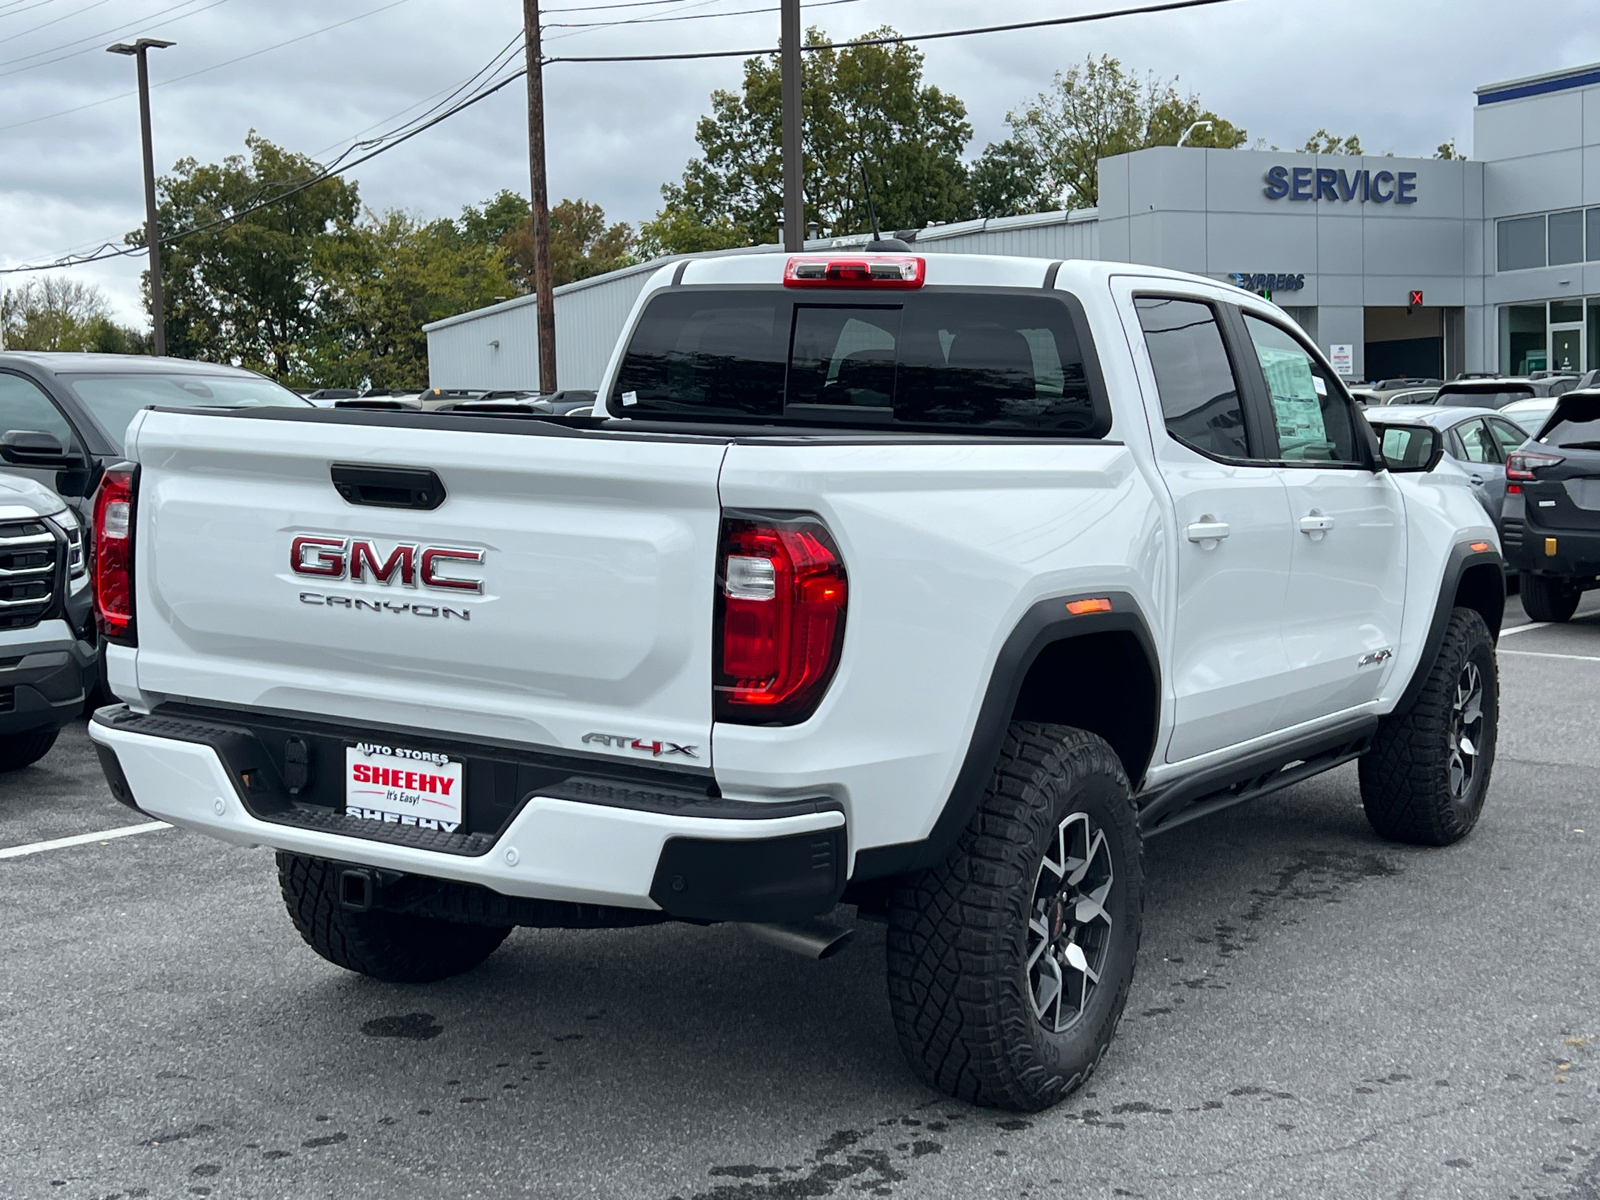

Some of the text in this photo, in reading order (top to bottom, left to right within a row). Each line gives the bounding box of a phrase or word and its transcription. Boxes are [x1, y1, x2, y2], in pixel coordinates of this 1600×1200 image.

[1265, 165, 1418, 204] SERVICE
[1233, 273, 1305, 291] EXPRESS
[290, 533, 485, 596] GMC
[299, 592, 471, 621] CANYON
[355, 742, 449, 764] AUTO STORES
[581, 732, 700, 759] AT4X
[352, 763, 455, 796] SHEEHY
[386, 790, 420, 806] It's Easy!
[345, 806, 460, 833] SHEEHY
